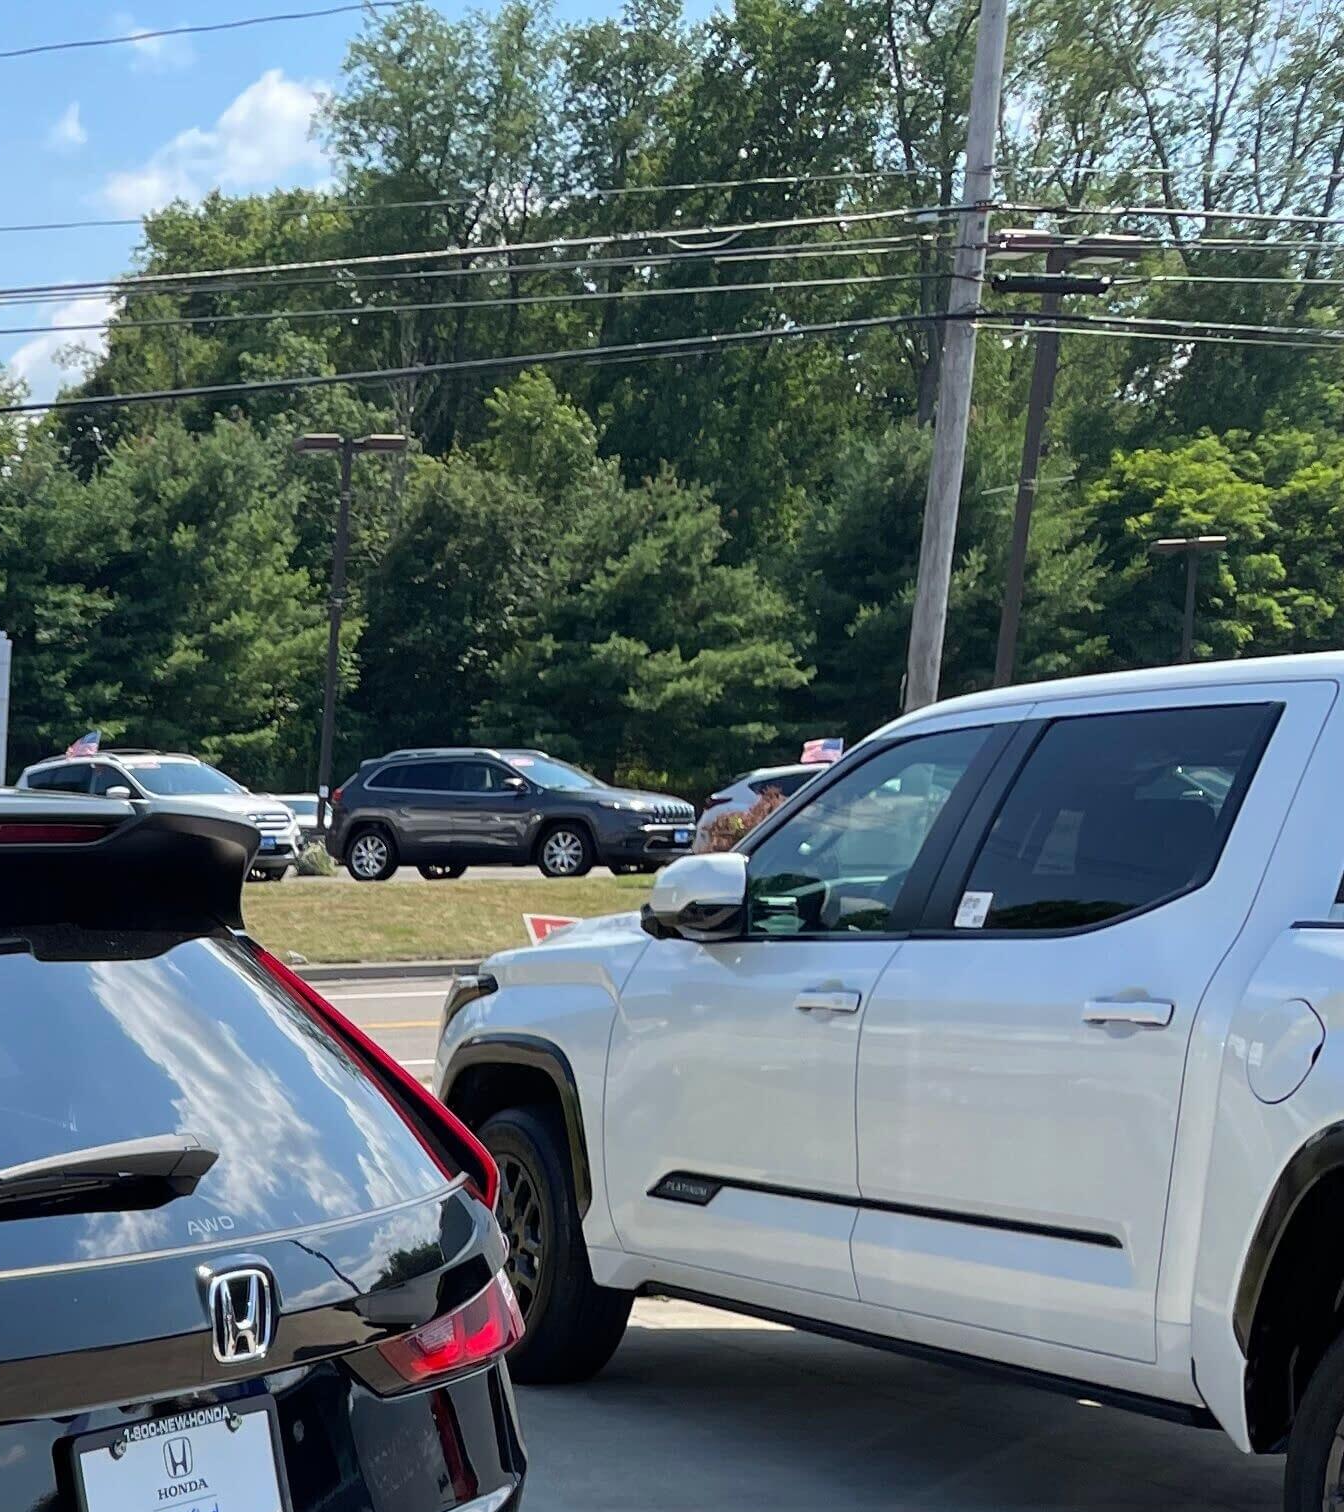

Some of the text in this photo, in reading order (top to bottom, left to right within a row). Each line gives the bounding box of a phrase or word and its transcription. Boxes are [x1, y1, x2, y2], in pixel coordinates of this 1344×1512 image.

[187, 1215, 235, 1236] AWD
[123, 1405, 231, 1444] 1-800-NEW-HONDA
[157, 1478, 209, 1501] HONDA
